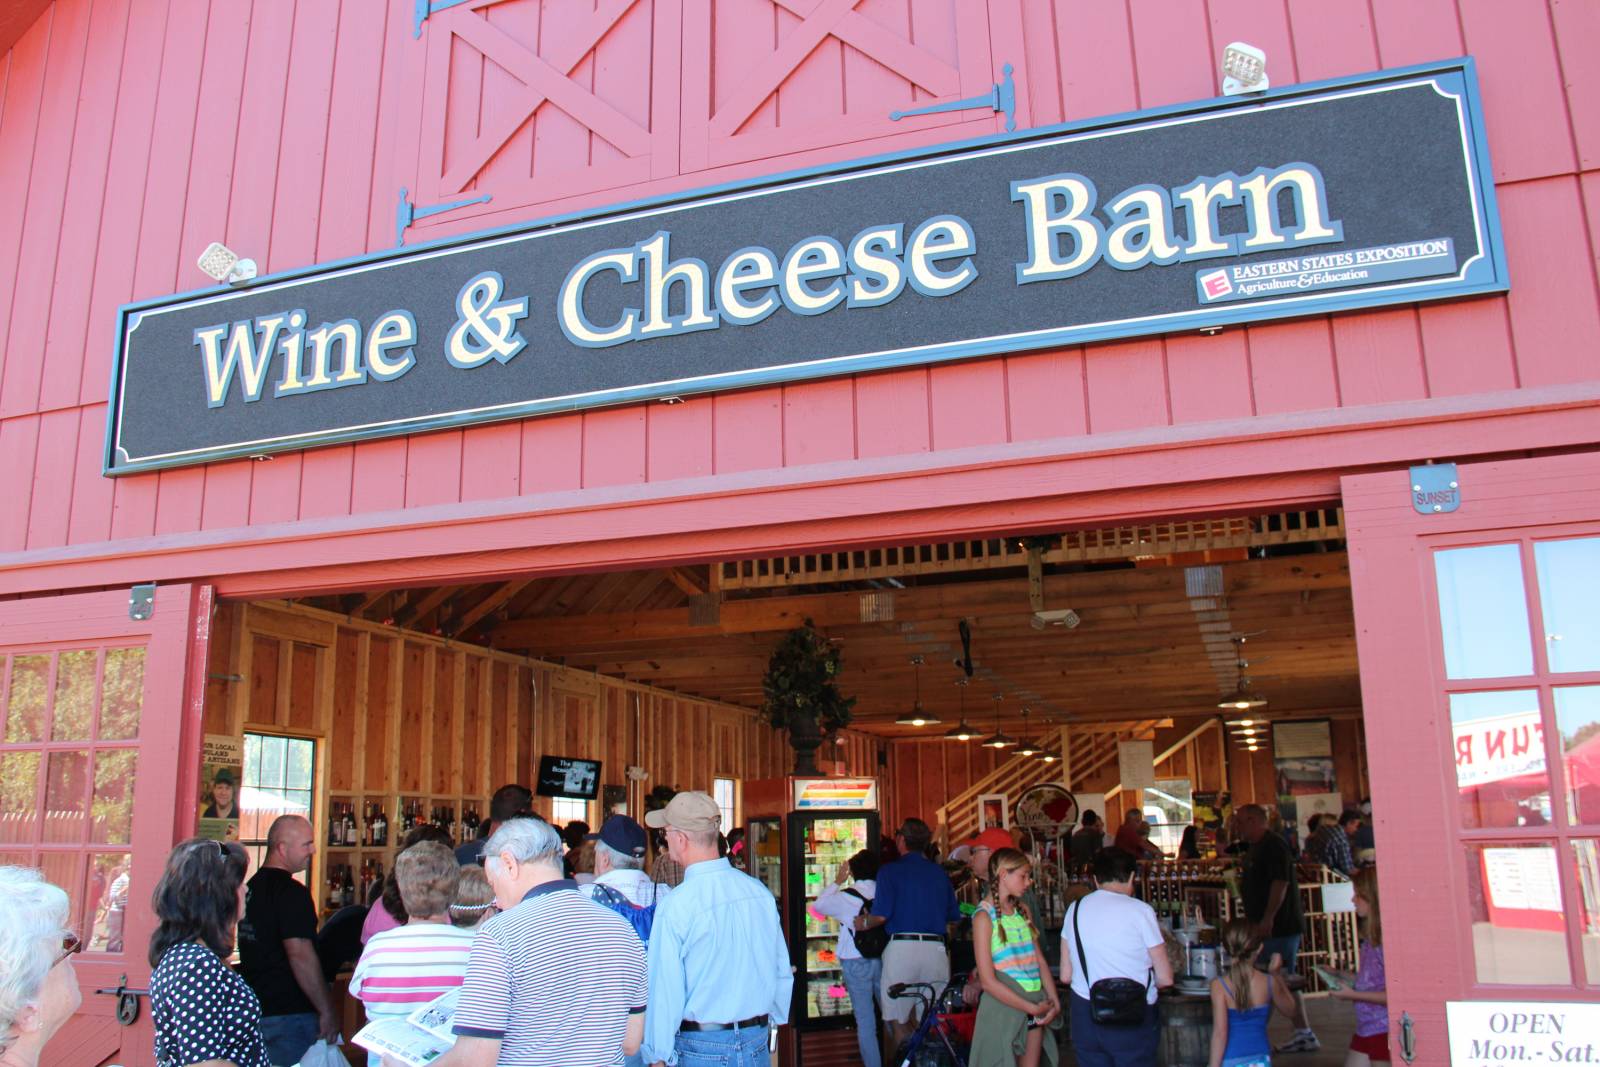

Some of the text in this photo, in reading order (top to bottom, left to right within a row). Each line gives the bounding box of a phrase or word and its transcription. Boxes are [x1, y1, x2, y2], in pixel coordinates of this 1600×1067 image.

[1233, 240, 1448, 280] EASTERN STATES EXPOSITION
[196, 166, 1340, 405] Wine & Cheese Barn
[1417, 490, 1456, 505] SUNSET
[215, 743, 237, 752] LOCAL
[1489, 1012, 1565, 1034] OPEN
